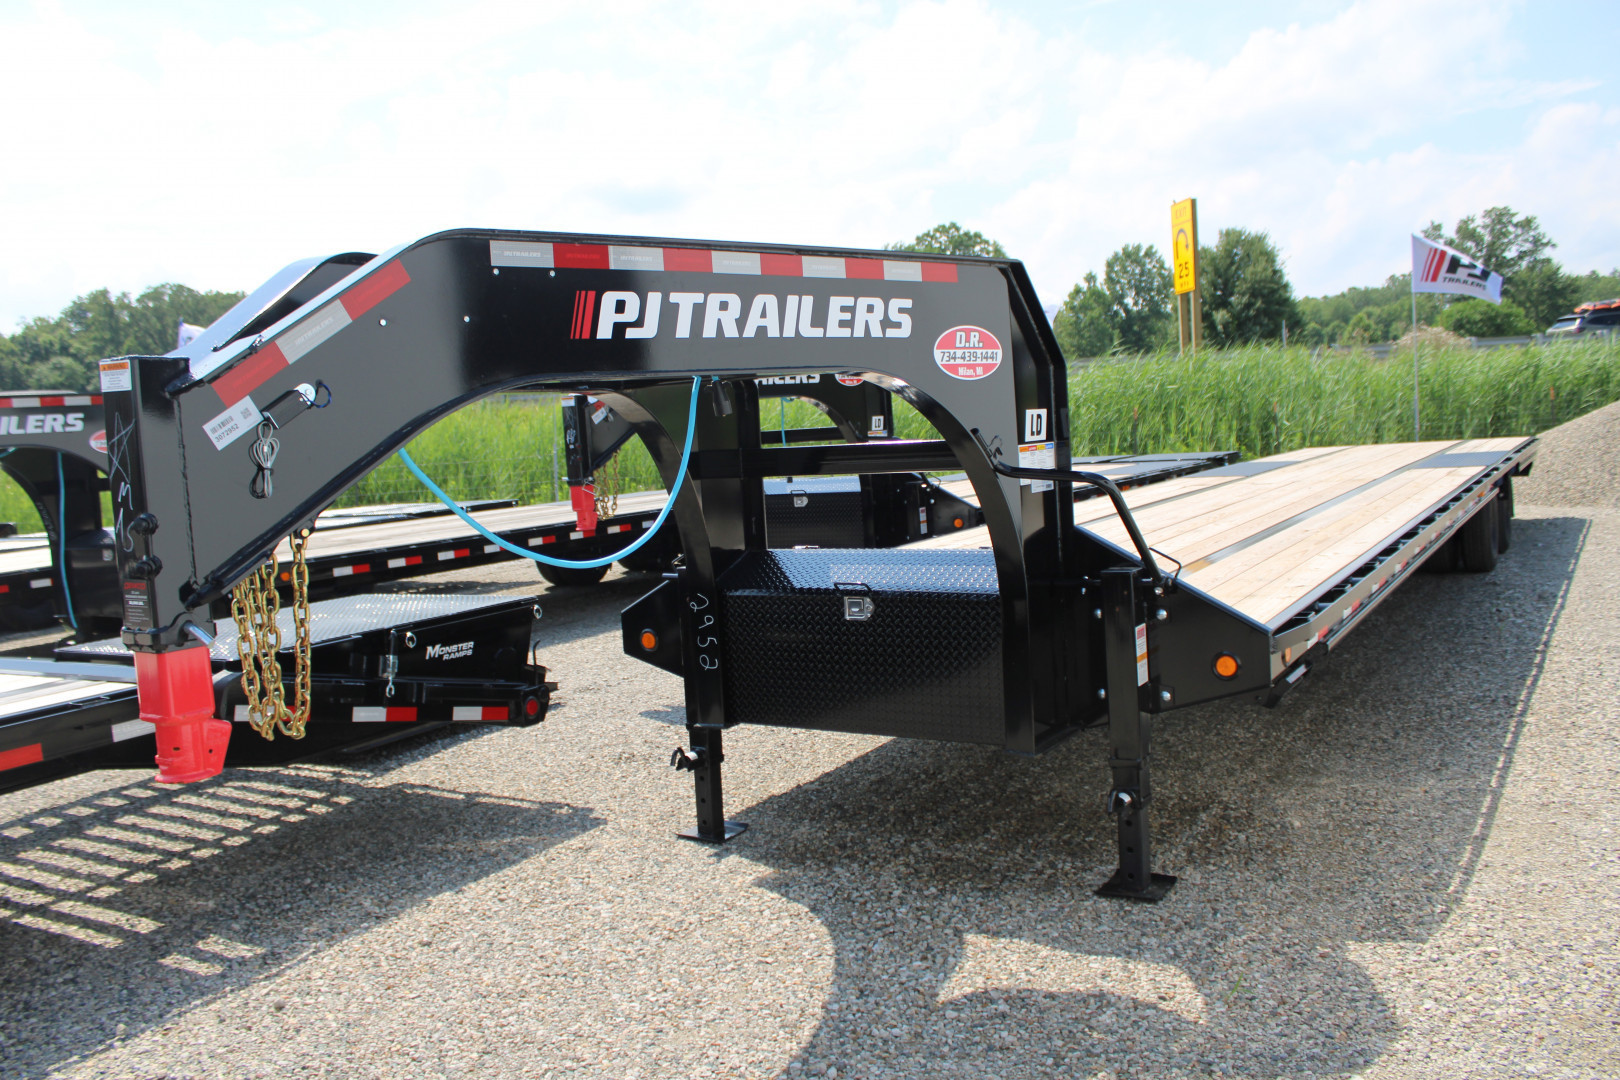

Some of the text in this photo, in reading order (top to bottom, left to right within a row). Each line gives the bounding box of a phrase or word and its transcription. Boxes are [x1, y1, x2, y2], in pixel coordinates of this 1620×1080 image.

[1178, 261, 1190, 279] 25
[1442, 276, 1487, 290] TRAILERS
[669, 292, 913, 338] TRAILERS
[955, 331, 983, 348] D.R.
[940, 351, 998, 362] 734-439-1441
[215, 423, 240, 442] 3072952
[1030, 413, 1043, 437] LD
[425, 641, 474, 660] MONSTER
[443, 649, 473, 661] RAMPS
